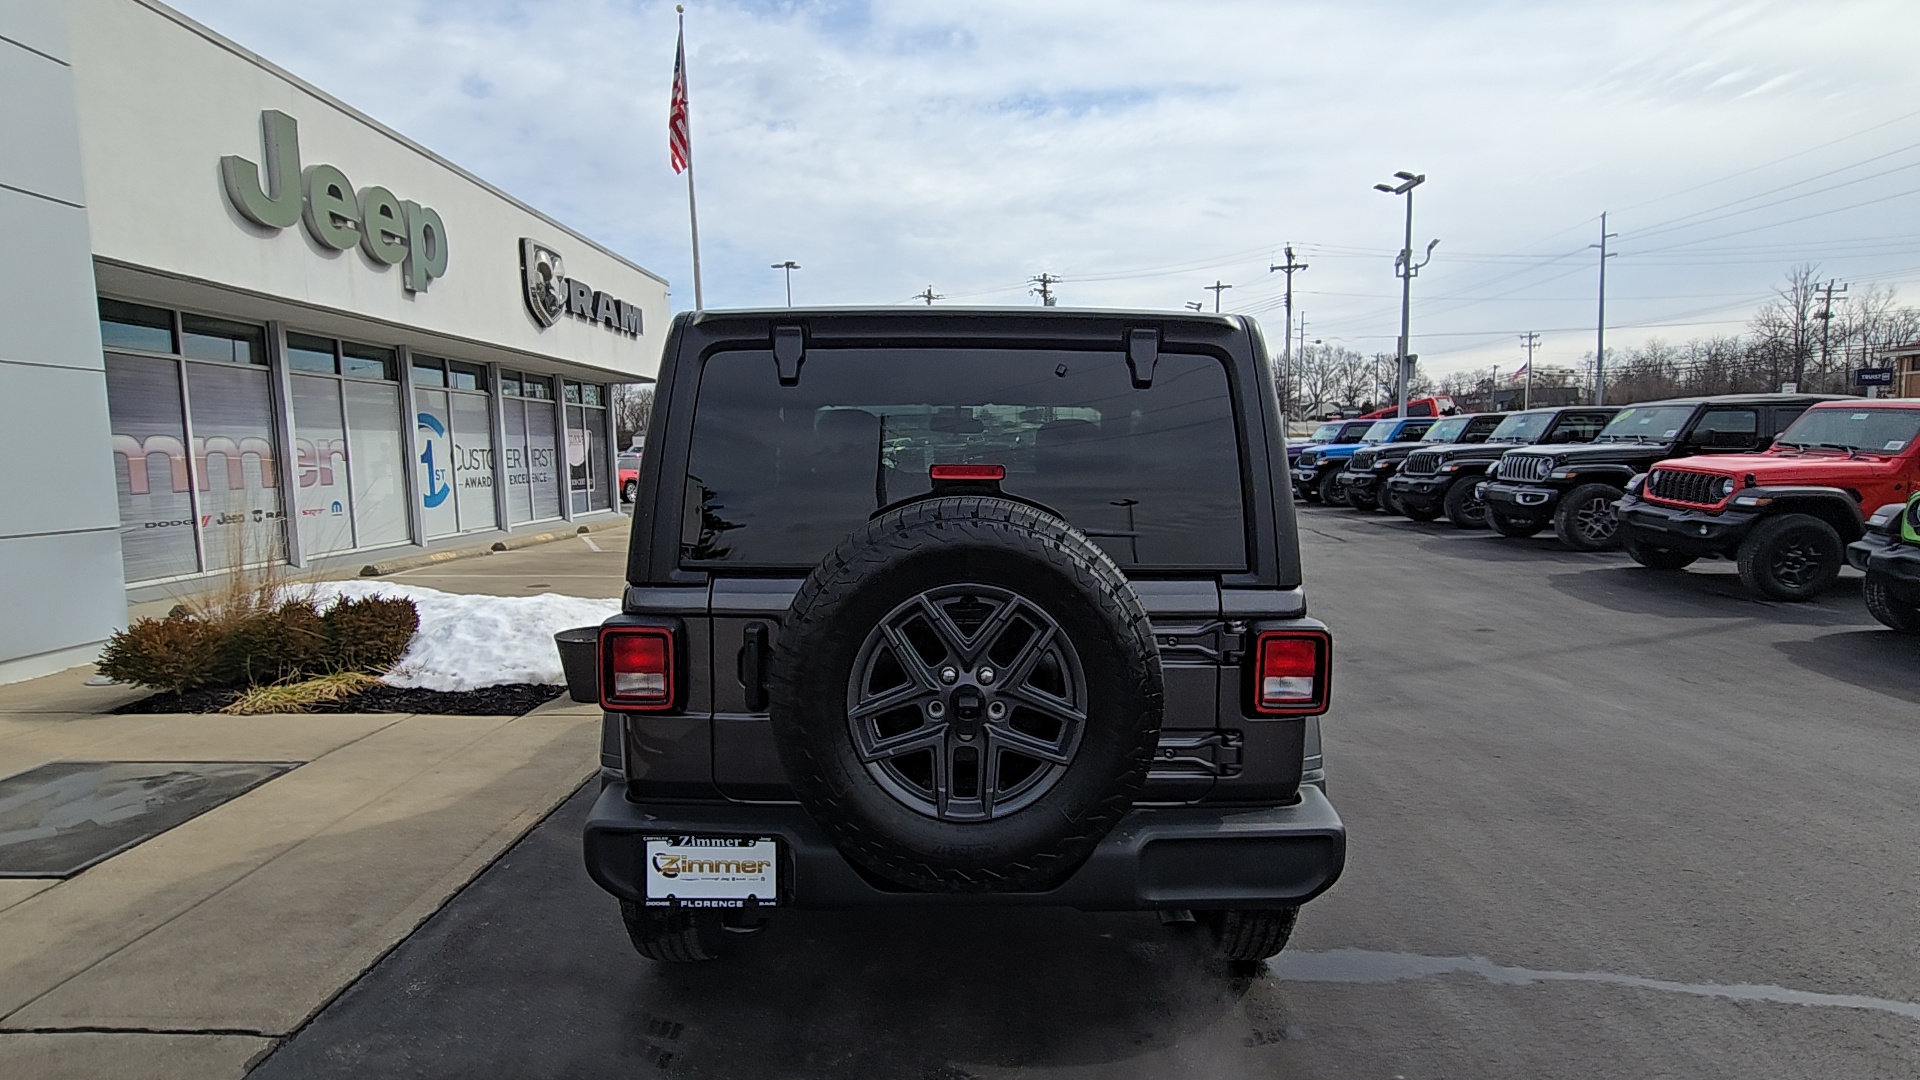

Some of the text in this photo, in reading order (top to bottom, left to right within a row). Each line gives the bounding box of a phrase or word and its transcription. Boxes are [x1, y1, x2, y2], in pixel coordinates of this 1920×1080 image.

[220, 110, 448, 294] Jeep
[565, 278, 643, 336] RAM
[452, 443, 522, 471] CUSTOER
[465, 472, 547, 488] AWARD EXCELENCE
[144, 519, 195, 529] DODG
[265, 511, 284, 519] RA
[679, 835, 742, 847] Zimmer
[659, 854, 772, 874] Zimmer
[680, 900, 744, 908] FLORENCE
